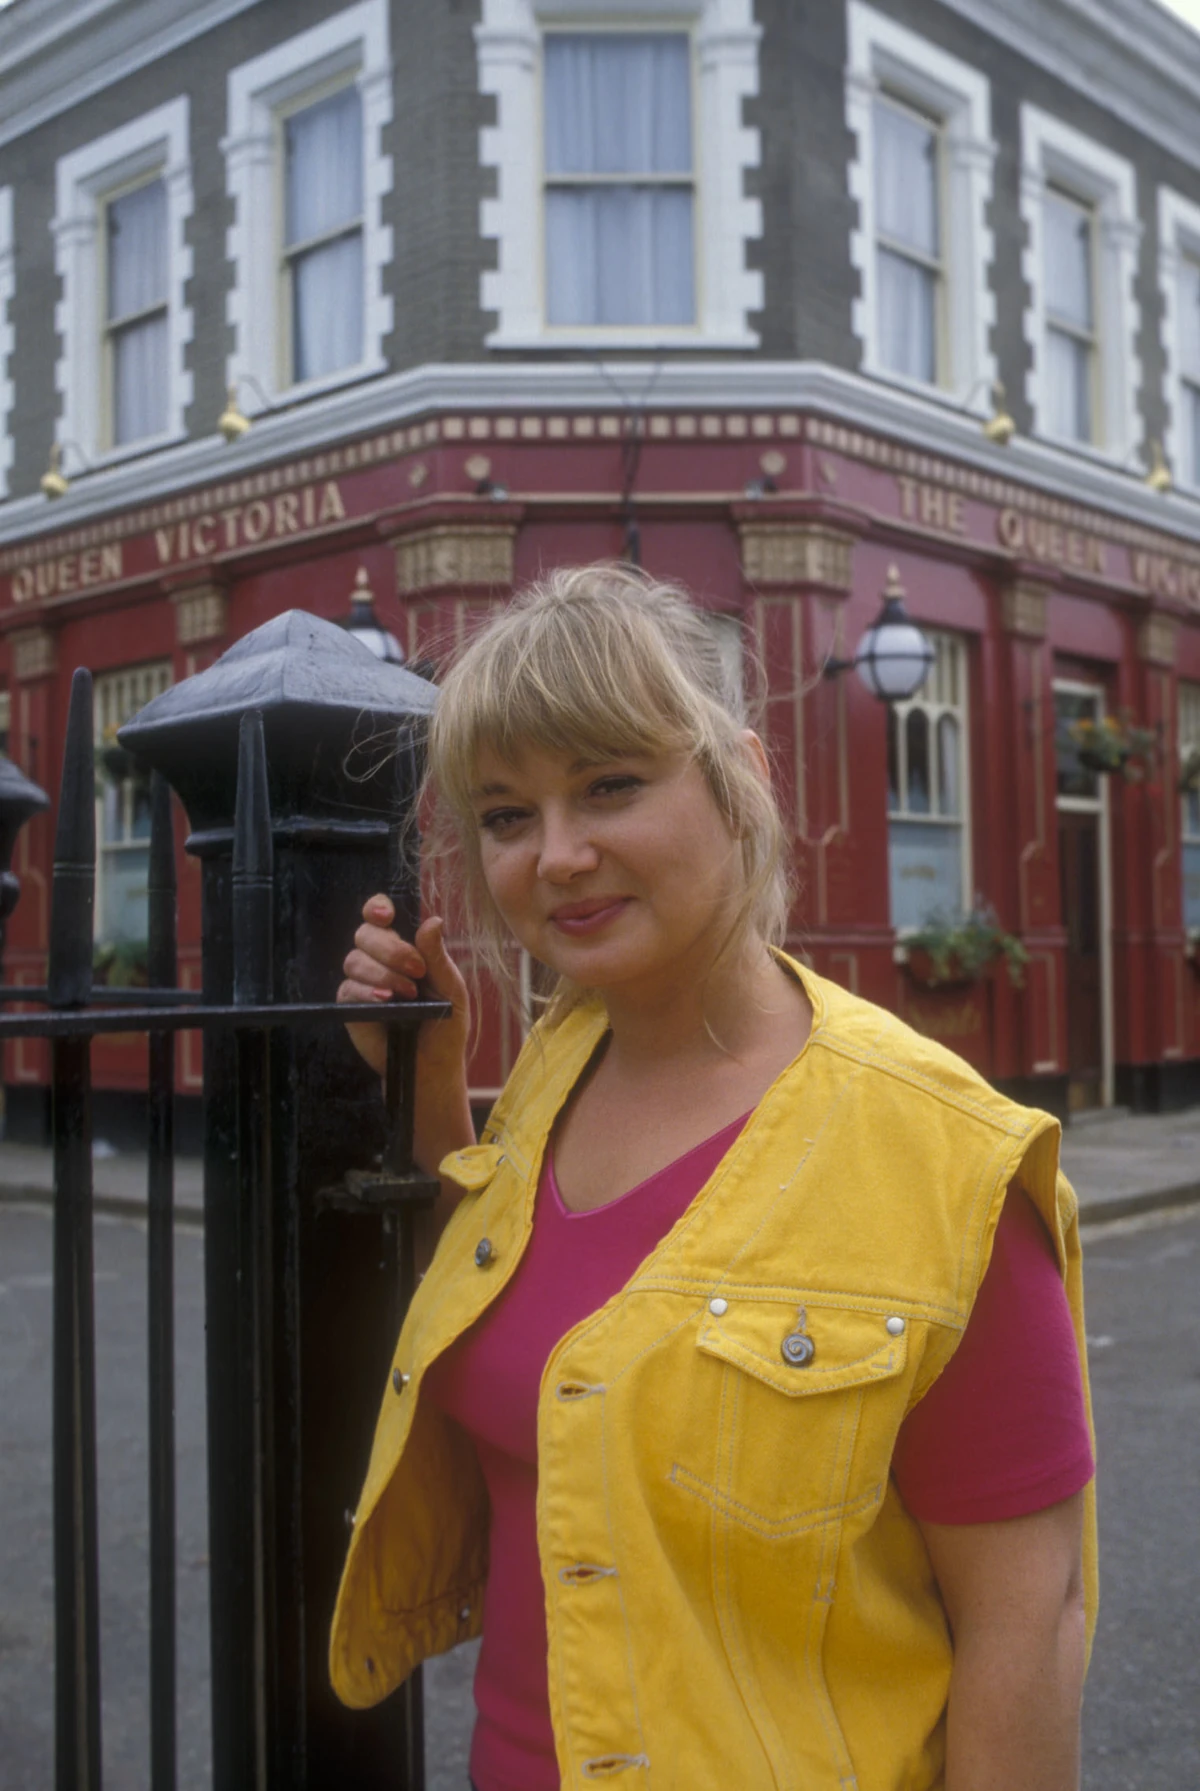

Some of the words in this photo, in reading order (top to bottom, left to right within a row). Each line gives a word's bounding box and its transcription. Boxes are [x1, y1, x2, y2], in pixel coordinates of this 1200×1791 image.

[11, 544, 123, 602] QUEEN
[154, 480, 346, 564] VICTORIA
[897, 474, 967, 536] THE
[998, 507, 1107, 573] QUEEN
